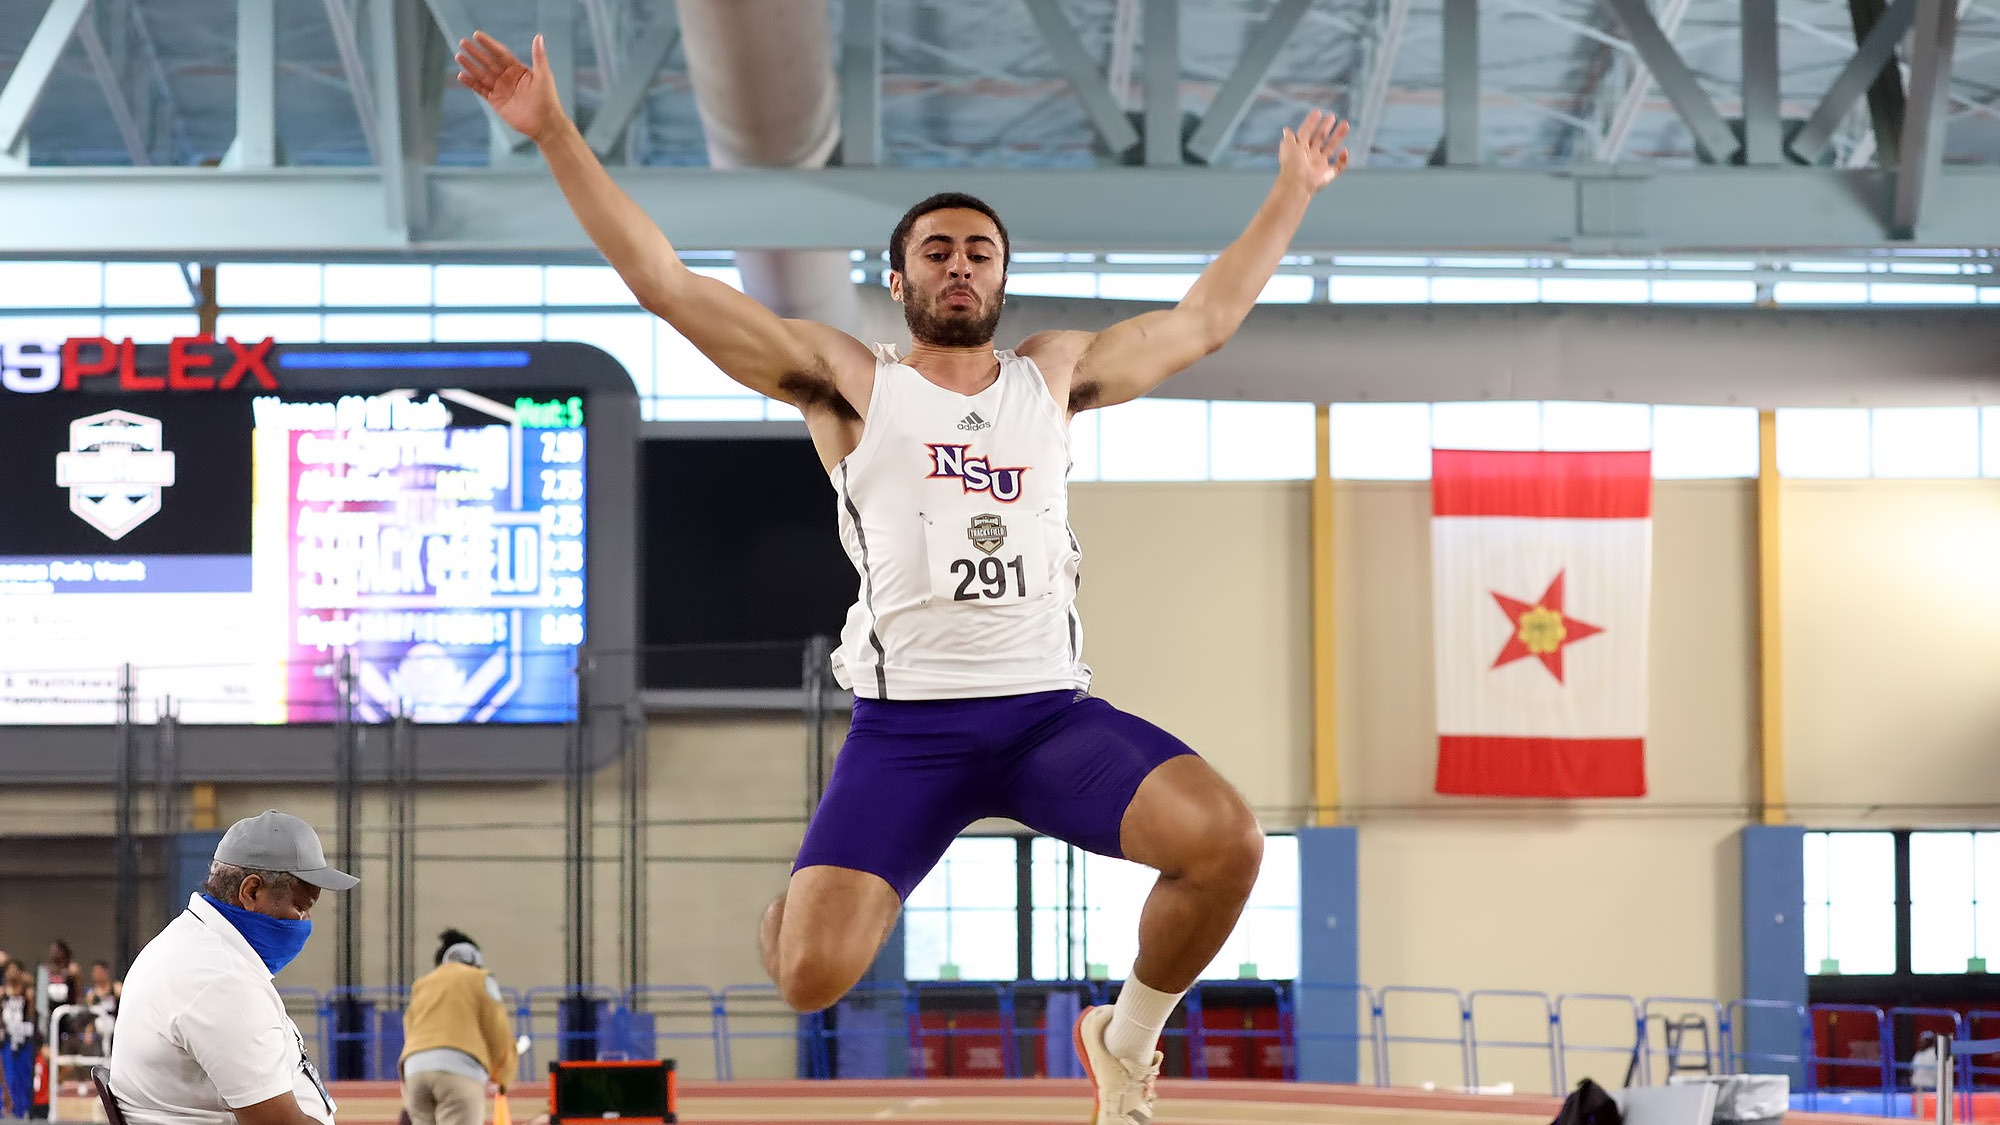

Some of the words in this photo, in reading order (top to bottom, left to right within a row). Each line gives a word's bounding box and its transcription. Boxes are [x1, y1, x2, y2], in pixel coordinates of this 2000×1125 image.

[957, 421, 991, 431] adidas
[929, 444, 1026, 502] NSU
[950, 555, 1026, 601] 291
